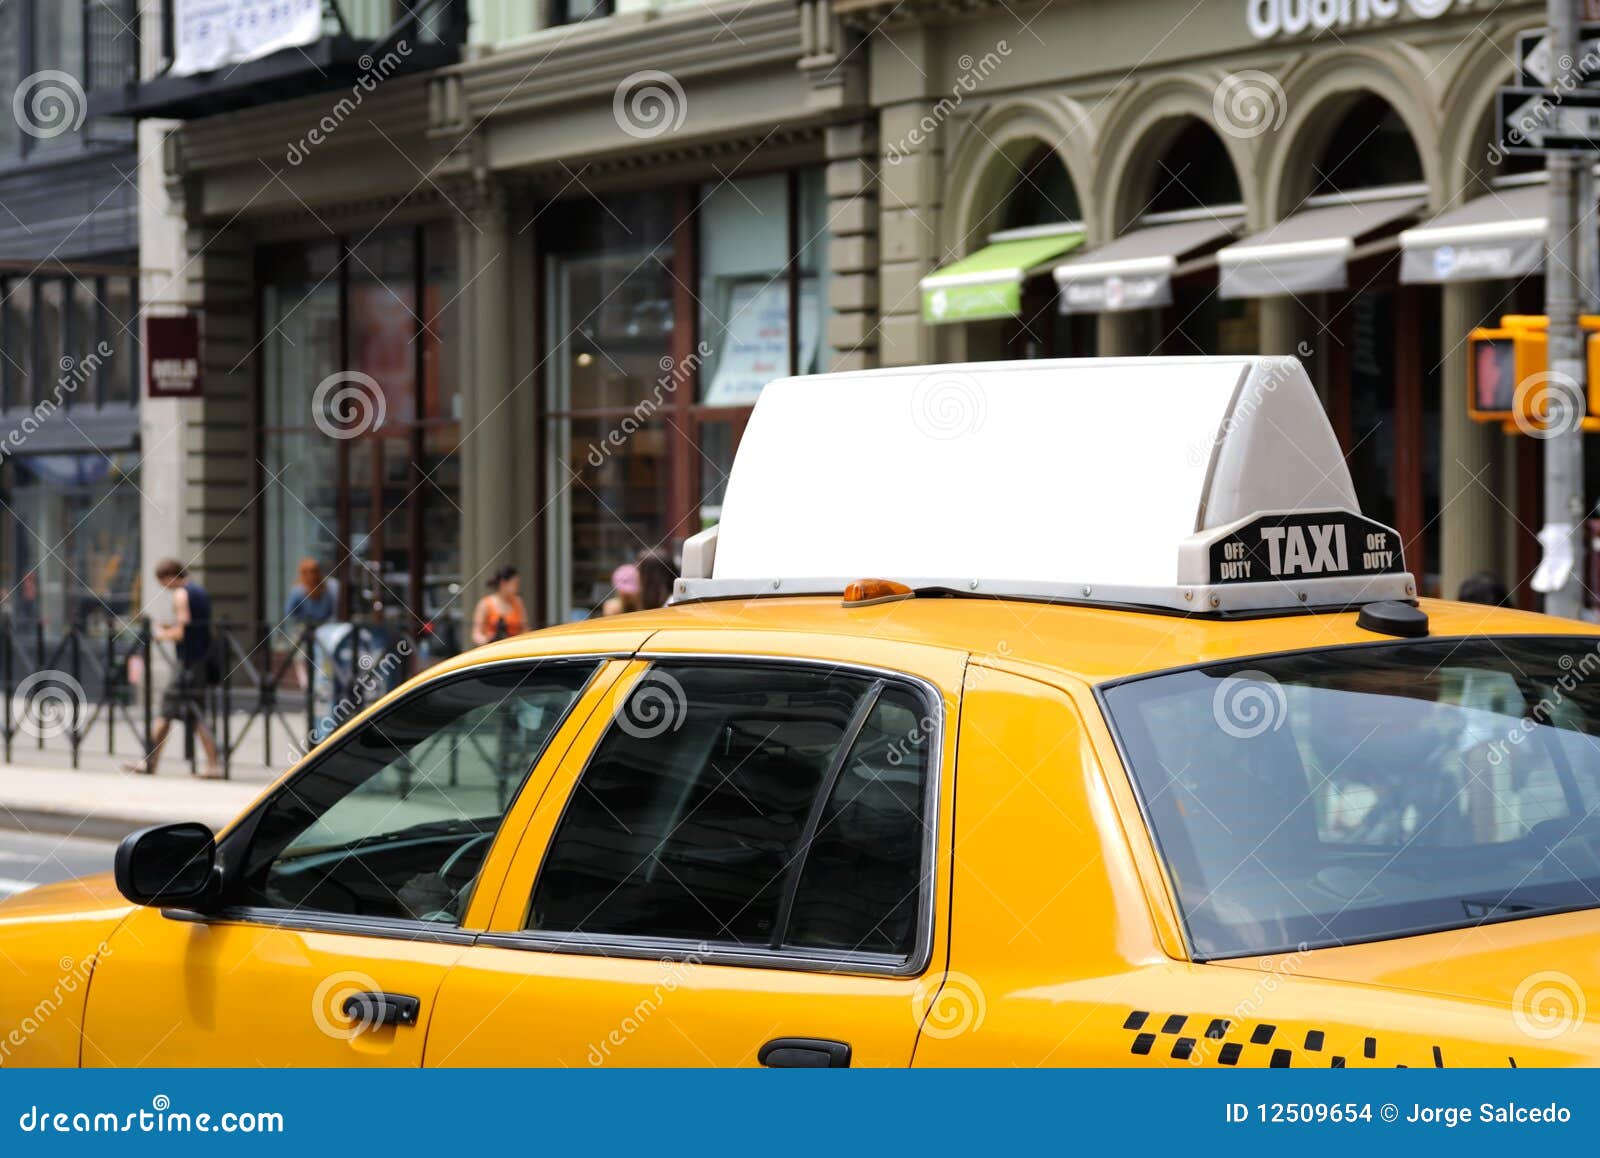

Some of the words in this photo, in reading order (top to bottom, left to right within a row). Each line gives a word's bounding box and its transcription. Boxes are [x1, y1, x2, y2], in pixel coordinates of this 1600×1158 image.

[1224, 542, 1245, 560] OFF
[1260, 524, 1349, 575] TAXI
[1366, 533, 1386, 550] OFF
[1363, 551, 1393, 570] DUTY
[1220, 561, 1251, 580] DUTY
